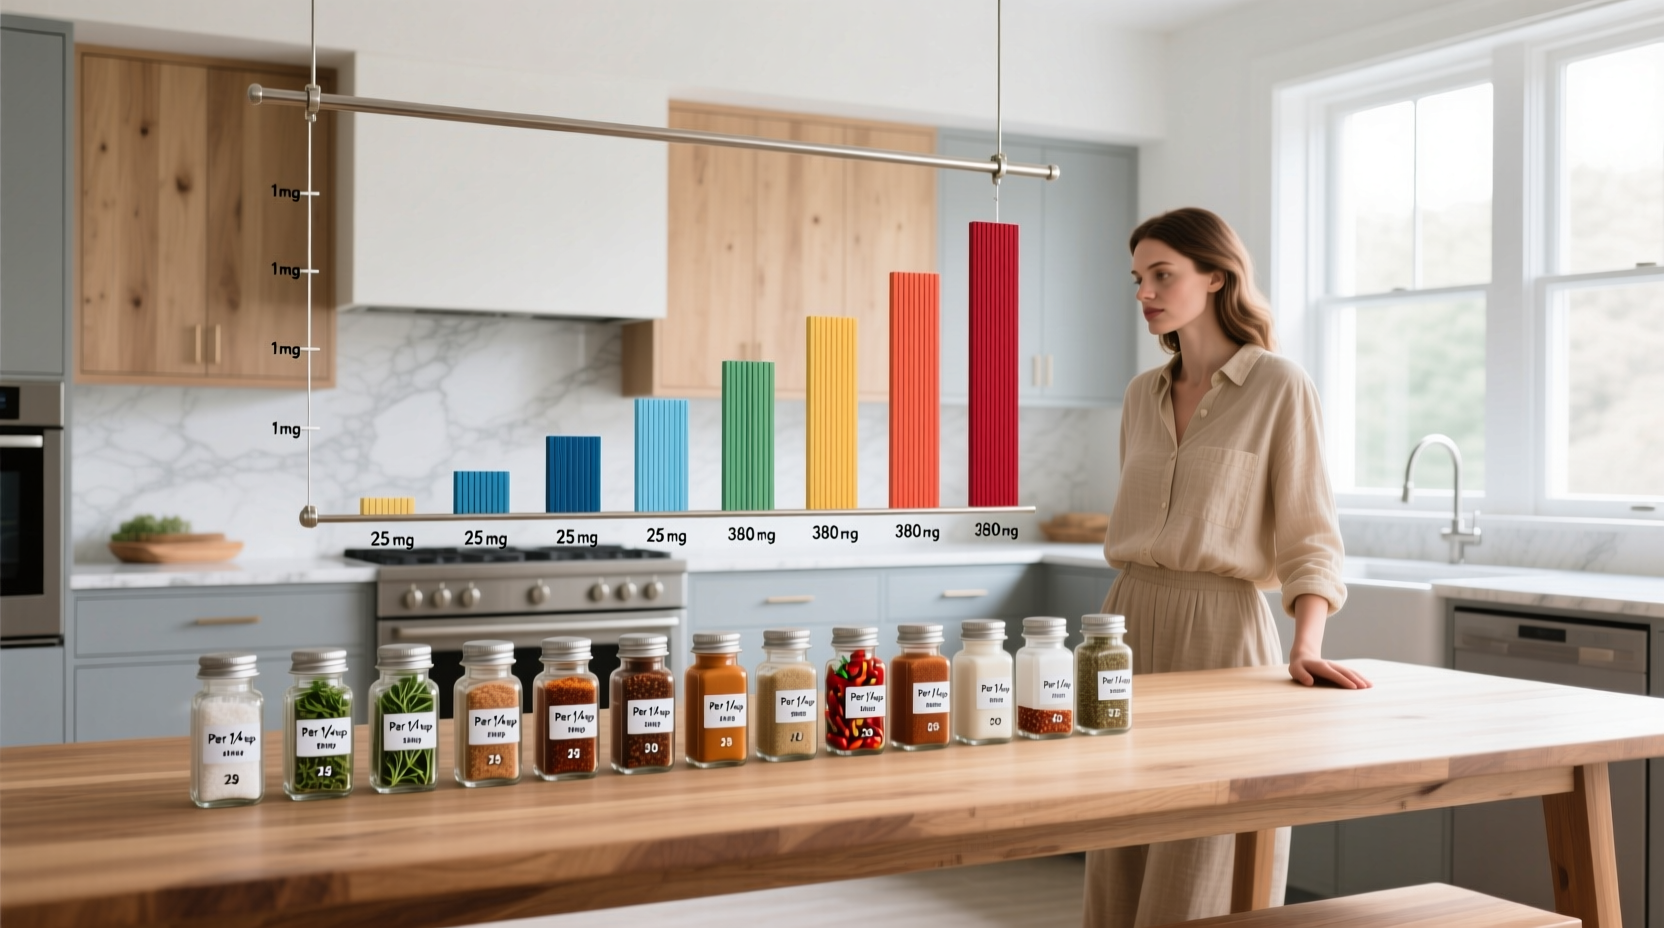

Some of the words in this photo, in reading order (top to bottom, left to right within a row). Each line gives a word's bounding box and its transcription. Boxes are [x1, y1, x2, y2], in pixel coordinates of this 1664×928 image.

[728, 526, 755, 541] 380
[812, 525, 839, 539] 380
[895, 523, 921, 538] 380
[371, 531, 390, 546] 25
[393, 536, 414, 550] mg
[464, 530, 483, 545] 25
[486, 535, 507, 549] mg
[556, 529, 575, 544] 25
[577, 533, 598, 547] mg
[647, 528, 665, 542] 25
[667, 532, 687, 546] mg
[850, 693, 864, 701] Per
[633, 707, 647, 716] Per
[709, 702, 723, 711] Per
[475, 716, 491, 726] Per
[555, 712, 571, 722] Per
[302, 727, 318, 737] Per
[389, 722, 405, 732] Per
[208, 733, 227, 745] Per
[224, 774, 240, 785] 29
